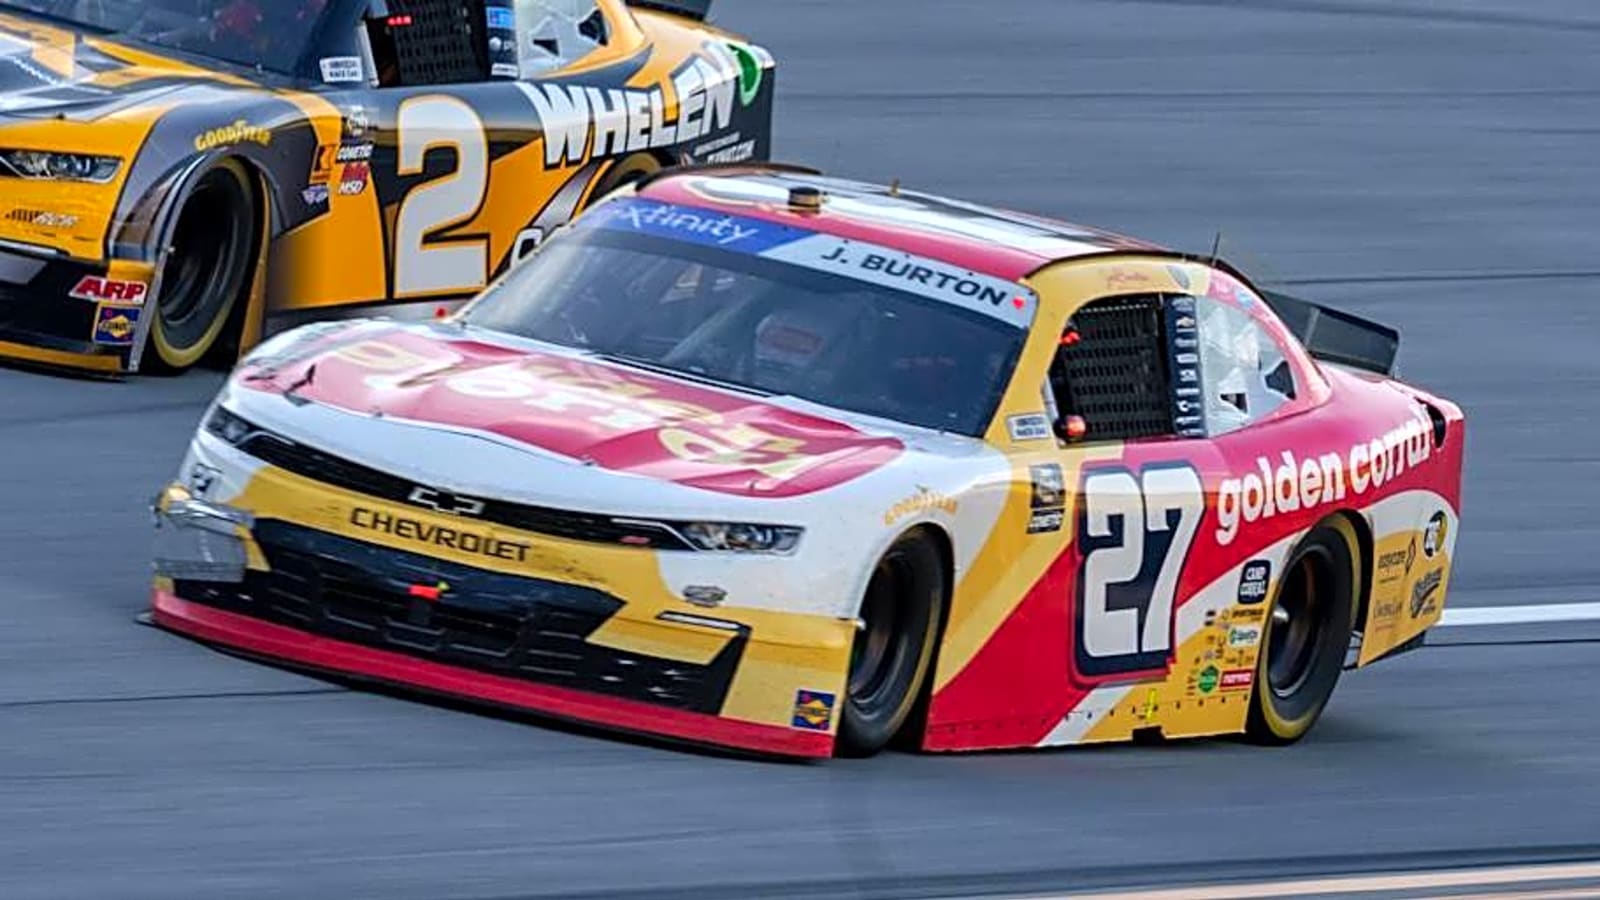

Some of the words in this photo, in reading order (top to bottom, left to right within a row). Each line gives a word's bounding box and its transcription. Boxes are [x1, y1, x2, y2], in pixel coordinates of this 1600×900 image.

[515, 56, 736, 166] WHELEN
[395, 95, 489, 294] 2
[75, 278, 146, 300] ARP
[820, 246, 848, 264] J.
[859, 252, 1008, 307] BURTON
[350, 506, 532, 563] CHEVROLET
[1214, 450, 1346, 546] golden
[1082, 466, 1202, 659] 27
